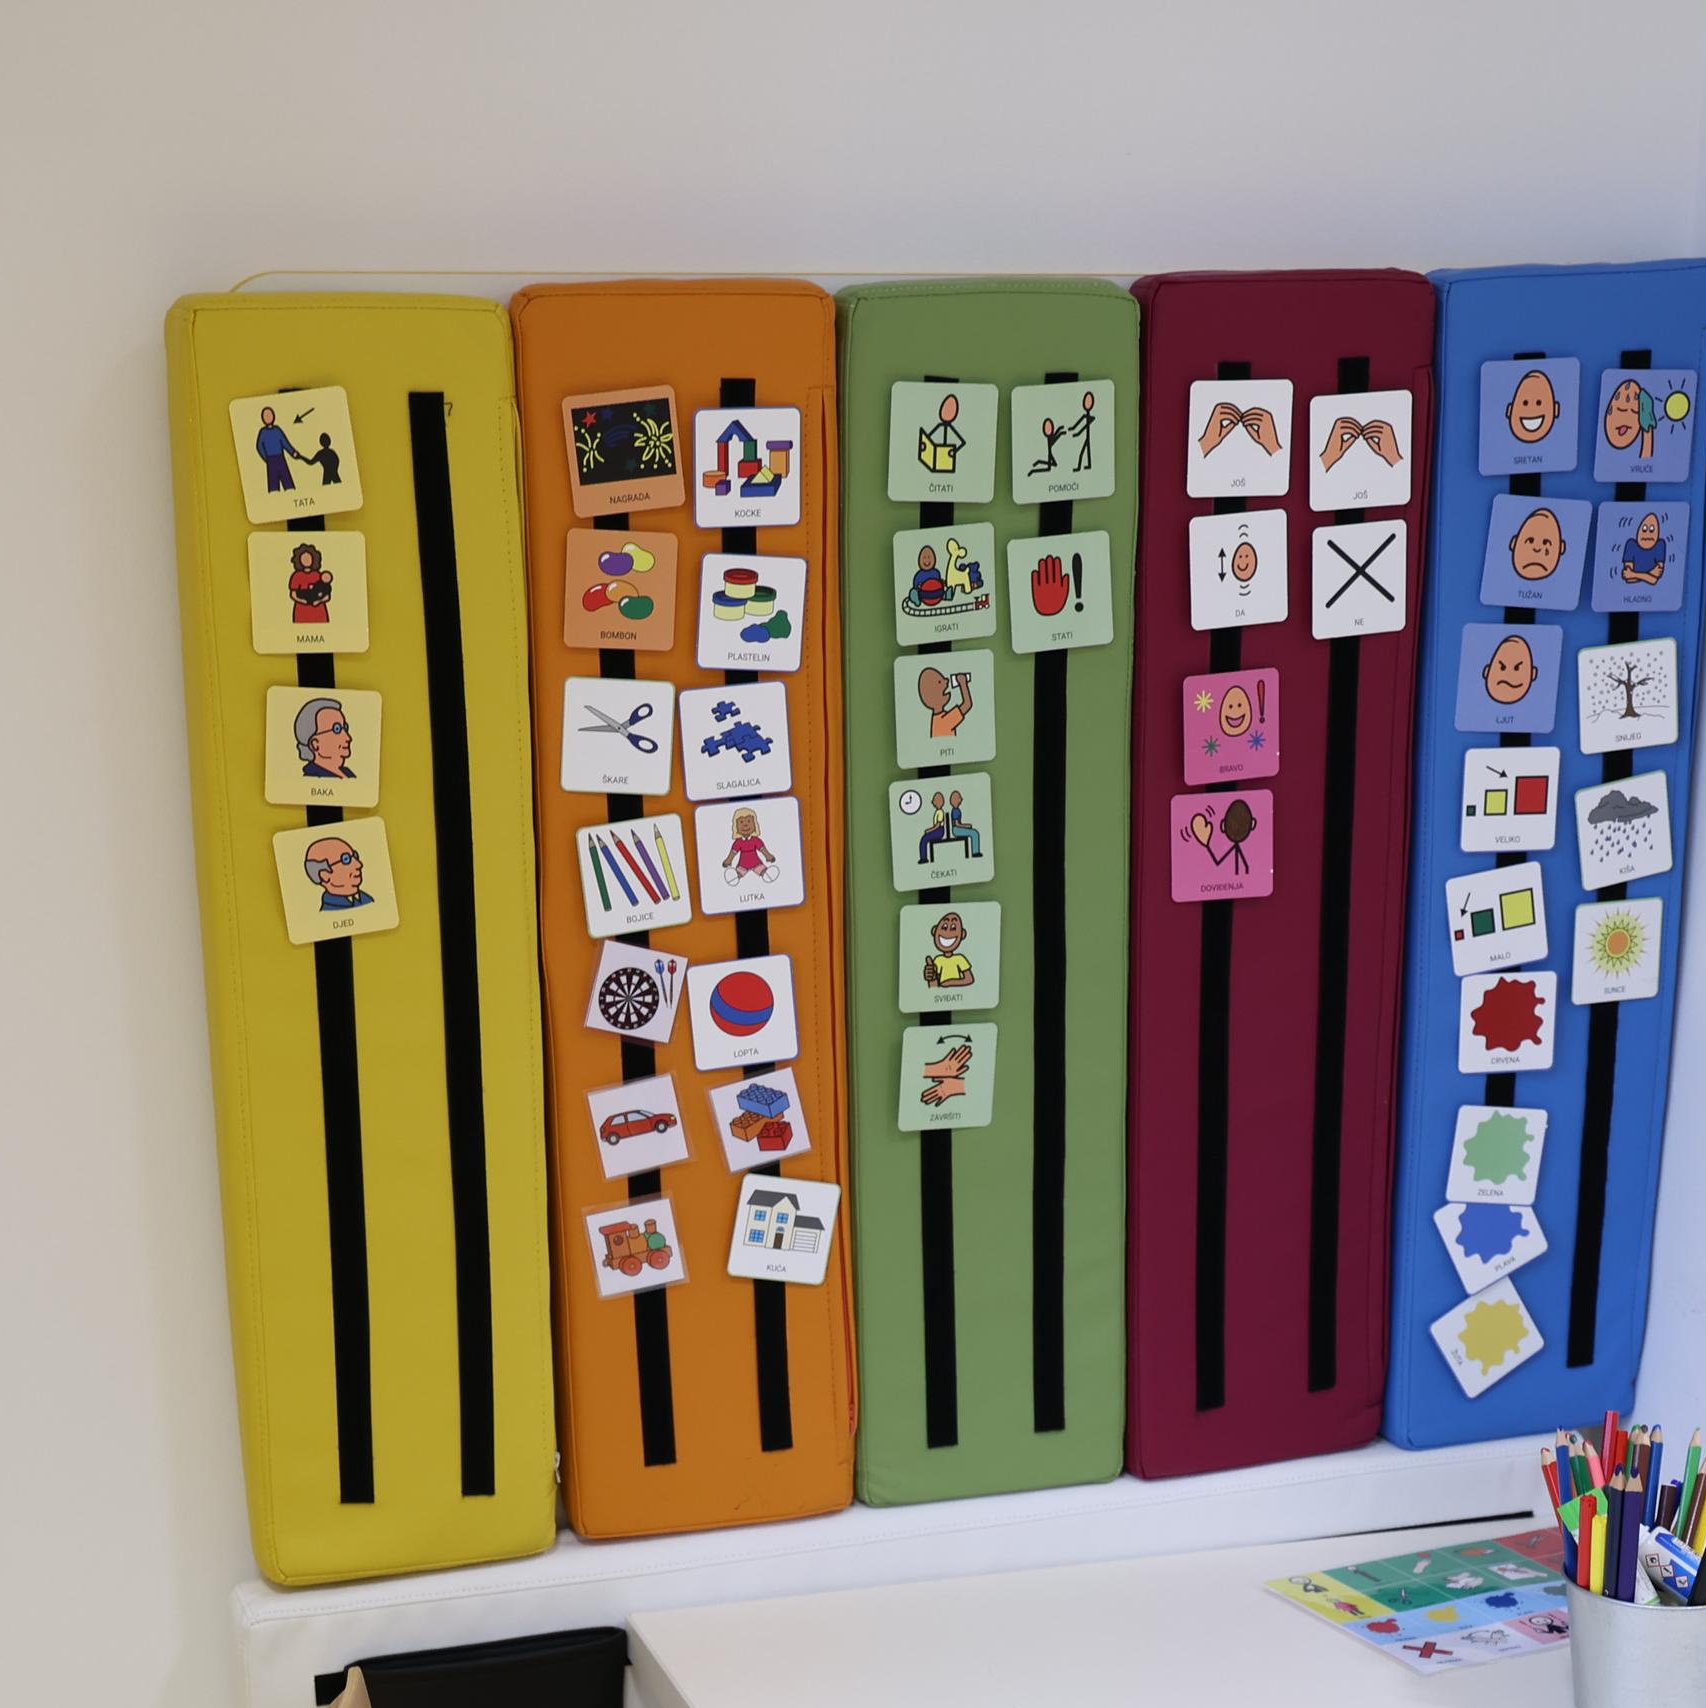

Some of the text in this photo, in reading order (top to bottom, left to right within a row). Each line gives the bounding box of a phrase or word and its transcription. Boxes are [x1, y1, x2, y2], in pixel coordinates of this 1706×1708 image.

[1513, 456, 1542, 464] SRETAN
[929, 483, 953, 492] ČITATI
[1048, 482, 1079, 492] POMOĆI
[1231, 478, 1245, 488] JOŠ
[609, 493, 651, 504] NAGRADA
[1353, 490, 1368, 500] JOŠ
[293, 497, 315, 508] TATA
[734, 509, 761, 518] KOCKE
[1518, 590, 1542, 600] TUŽAN
[1235, 609, 1245, 617] DA
[1354, 618, 1364, 626] NE
[934, 623, 958, 632] IGRATI
[296, 635, 325, 644] MAMA
[600, 631, 637, 640] BOMBON
[1052, 632, 1073, 641] STATI
[727, 652, 770, 662] PLASTELIN
[1496, 716, 1514, 725] LJUT
[1615, 733, 1641, 742] SNIJEG
[940, 749, 954, 757] PITI
[1219, 764, 1243, 773] BRAVO
[602, 775, 629, 784] ŠKARE
[716, 778, 760, 790] SLAGALICA
[310, 788, 334, 796] BAKA
[1495, 835, 1520, 843] VELIKO
[931, 869, 957, 879] ČEKATI
[1619, 865, 1635, 875] KIŠA
[739, 893, 765, 902] LUTKA
[626, 913, 654, 924] BOJICE
[332, 919, 354, 929] DJED
[1490, 952, 1511, 962] MALO
[733, 1048, 759, 1058] LOPTA
[1491, 1056, 1520, 1065] CRVENA
